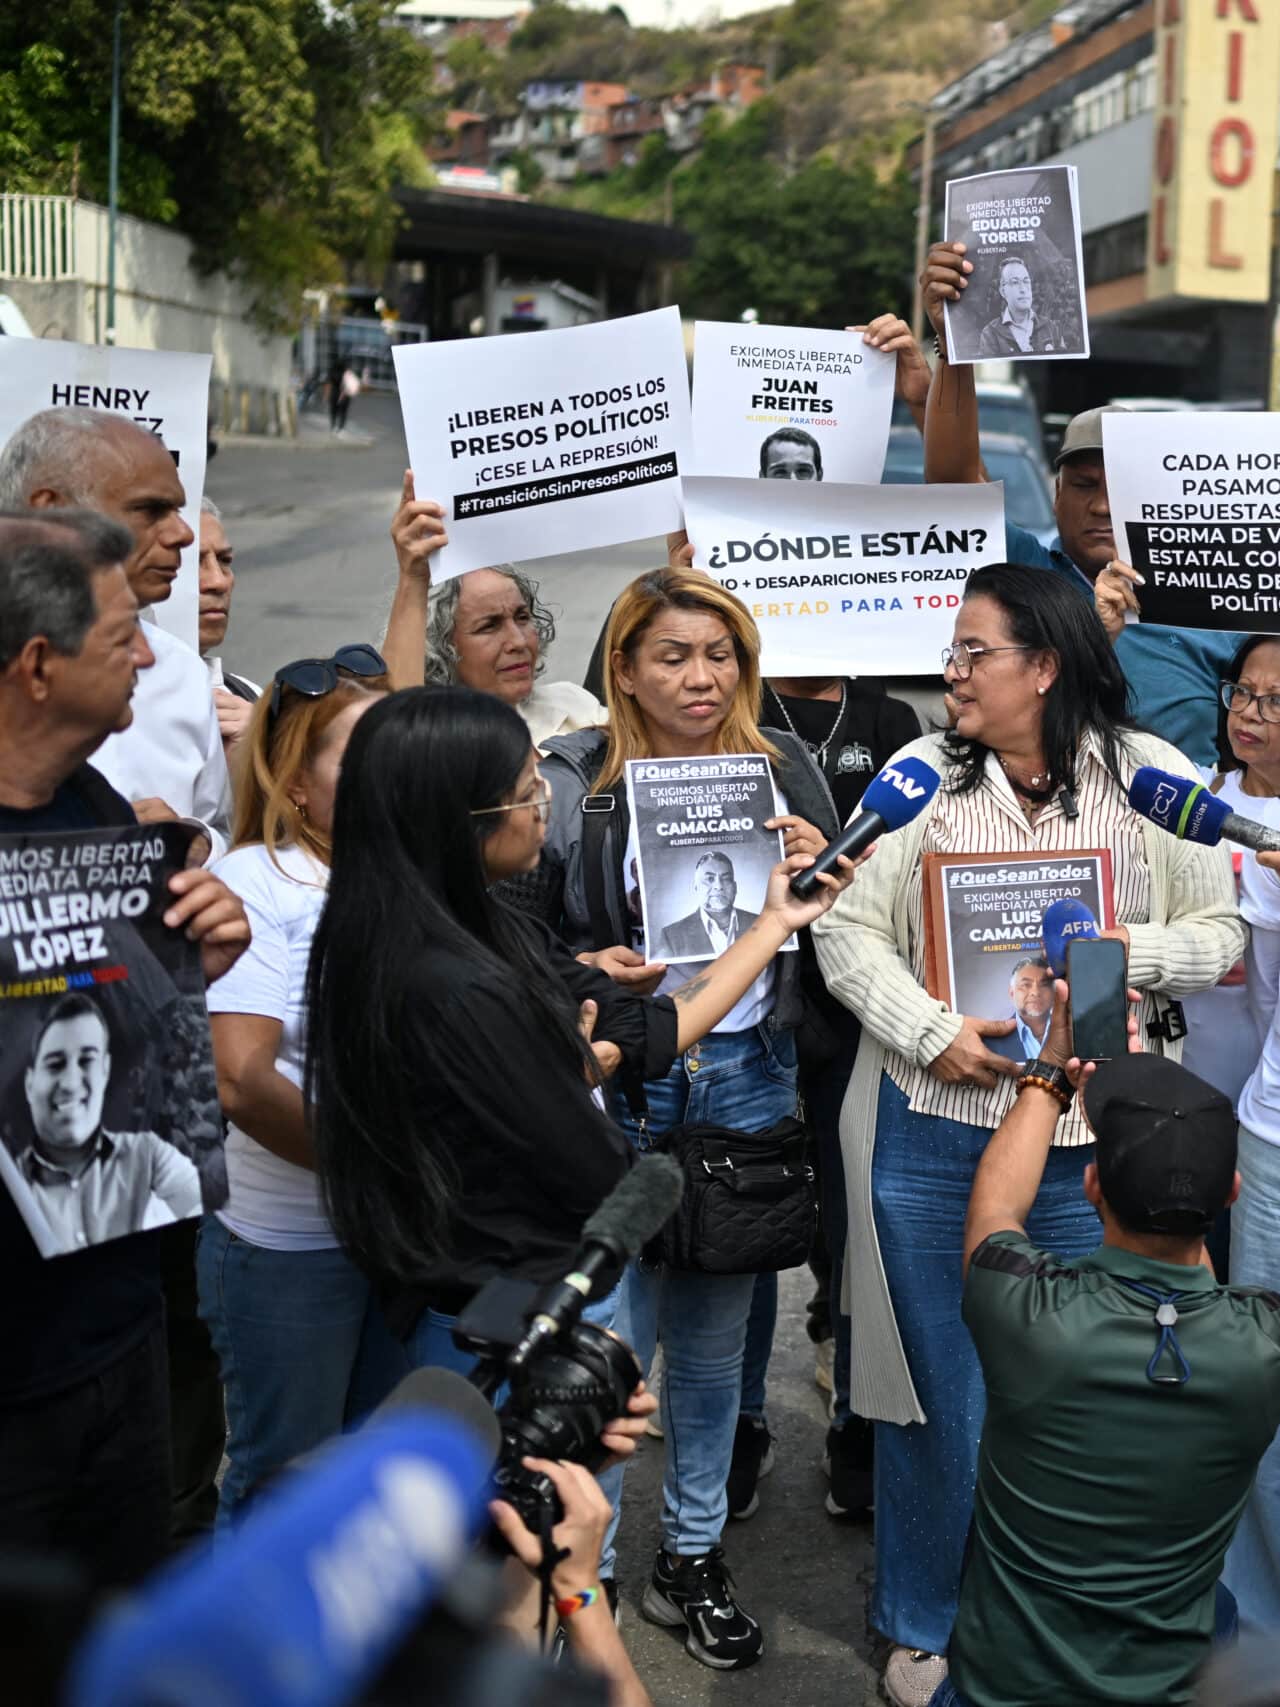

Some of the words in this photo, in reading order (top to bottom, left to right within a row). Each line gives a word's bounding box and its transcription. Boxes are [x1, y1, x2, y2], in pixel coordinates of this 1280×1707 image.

[967, 200, 1005, 213] EXIGIMOS
[1008, 196, 1051, 207] LIBERTAD
[970, 208, 1017, 219] INMEDIATA
[1020, 206, 1045, 214] PARA
[972, 216, 1041, 231] EDUARDO
[979, 230, 1034, 244] TORRES
[730, 345, 795, 359] EXIGIMOS
[800, 351, 863, 364] LIBERTAD
[737, 357, 812, 372] INMEDIATA
[816, 363, 851, 374] PARA
[762, 378, 818, 394] JUAN
[52, 384, 150, 410] HENRY
[448, 402, 543, 433] ¡LIBEREN
[550, 399, 564, 414] A
[569, 385, 632, 410] TODOS
[636, 377, 665, 397] LOS
[752, 395, 833, 413] FREITES
[451, 427, 548, 459] PRESOS
[555, 402, 670, 441] POLÍTICOS!
[475, 462, 526, 486] ¡CESE
[533, 457, 554, 473] LA
[560, 435, 658, 468] REPRESIÓN!
[1162, 454, 1229, 471] CADA
[459, 461, 673, 513] #TransiciónSinPresosPolíticos
[1148, 527, 1226, 544] FORMA
[1231, 527, 1262, 543] DE
[708, 533, 852, 569] ¿DÓNDE
[861, 524, 988, 557] ESTÁN?
[1149, 549, 1240, 566] ESTATAL
[755, 572, 897, 589] DESAPARICIONES
[1154, 571, 1251, 589] FAMILIAS
[753, 600, 830, 617] ERTAD
[841, 597, 903, 612] PARA
[913, 594, 959, 609] TOD
[635, 760, 764, 780] #QueSeanTodos
[650, 785, 703, 798] EXIGIMOS
[706, 782, 757, 794] LIBERTAD
[657, 795, 718, 806] INMEDIATA
[721, 792, 750, 802] PARA
[686, 805, 723, 819] LUIS
[1189, 803, 1208, 837] Noticias
[656, 818, 754, 836] CAMACARO
[60, 838, 165, 867] LIBERTAD
[87, 864, 152, 888] PARA
[949, 864, 1091, 885] #QueSeanTodos
[964, 891, 1021, 904] EXIGIMOS
[1024, 887, 1081, 900] LIBERTAD
[971, 900, 1036, 912] INMEDIATA
[1002, 911, 1042, 925] LUIS
[1061, 920, 1092, 937] AFP
[13, 926, 108, 973] LÓPEZ
